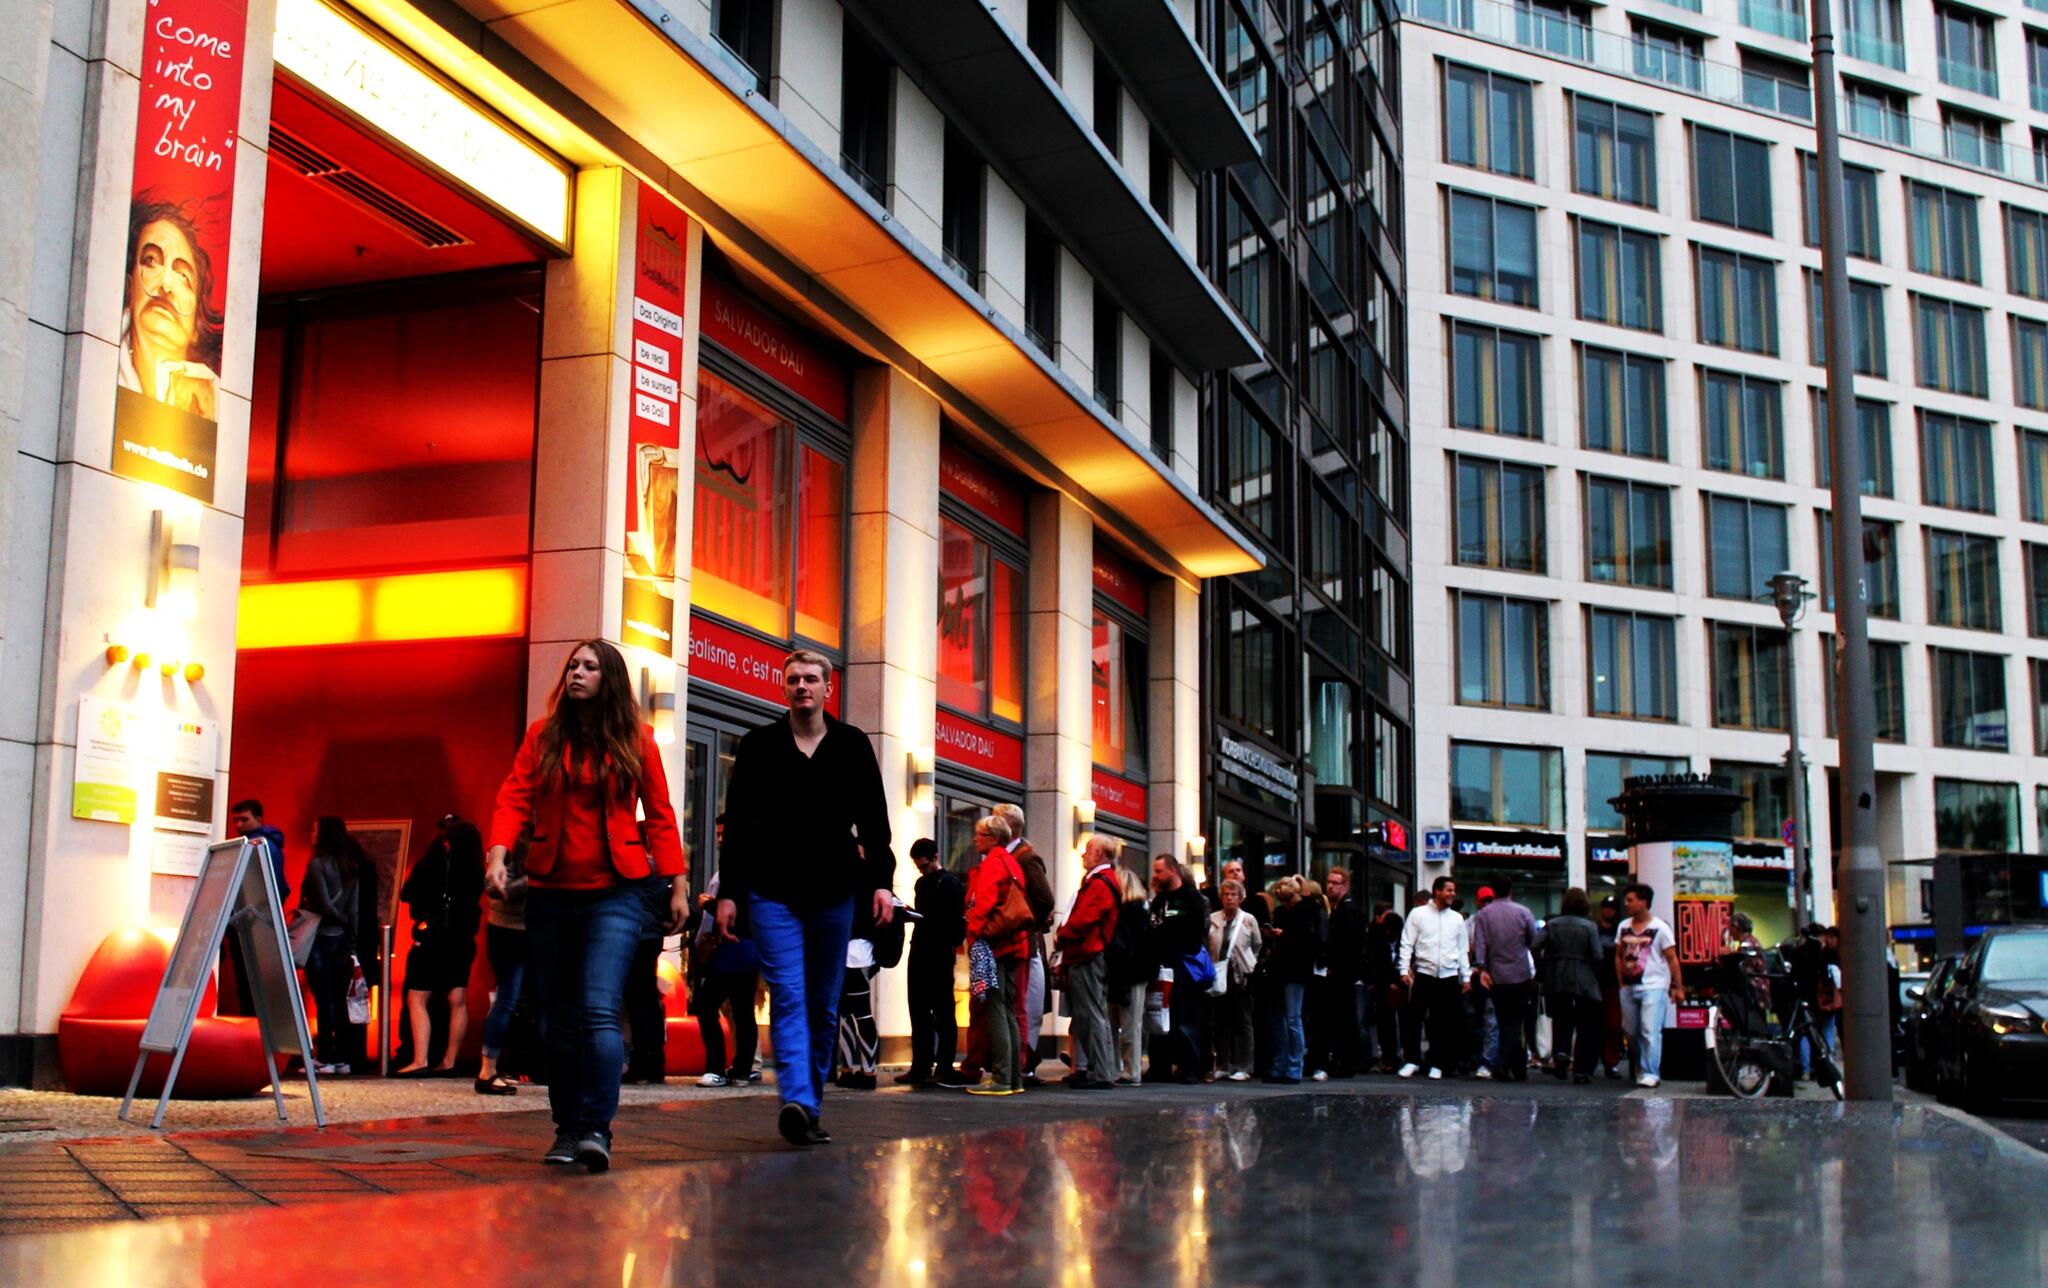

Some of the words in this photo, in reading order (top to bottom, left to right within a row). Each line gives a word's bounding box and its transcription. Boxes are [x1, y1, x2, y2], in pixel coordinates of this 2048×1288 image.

[155, 46, 212, 90] into
[155, 93, 196, 131] my
[639, 305, 652, 320] Das
[653, 311, 678, 330] Original
[715, 300, 777, 360] SALVADOR
[640, 347, 650, 360] be
[651, 352, 664, 365] real
[640, 374, 650, 387] be
[651, 380, 673, 395] surreal
[641, 401, 650, 414] be
[742, 654, 769, 681] c'est
[935, 721, 977, 752] SALVADOR
[1425, 850, 1450, 861] Bank
[1476, 842, 1512, 855] Berliner
